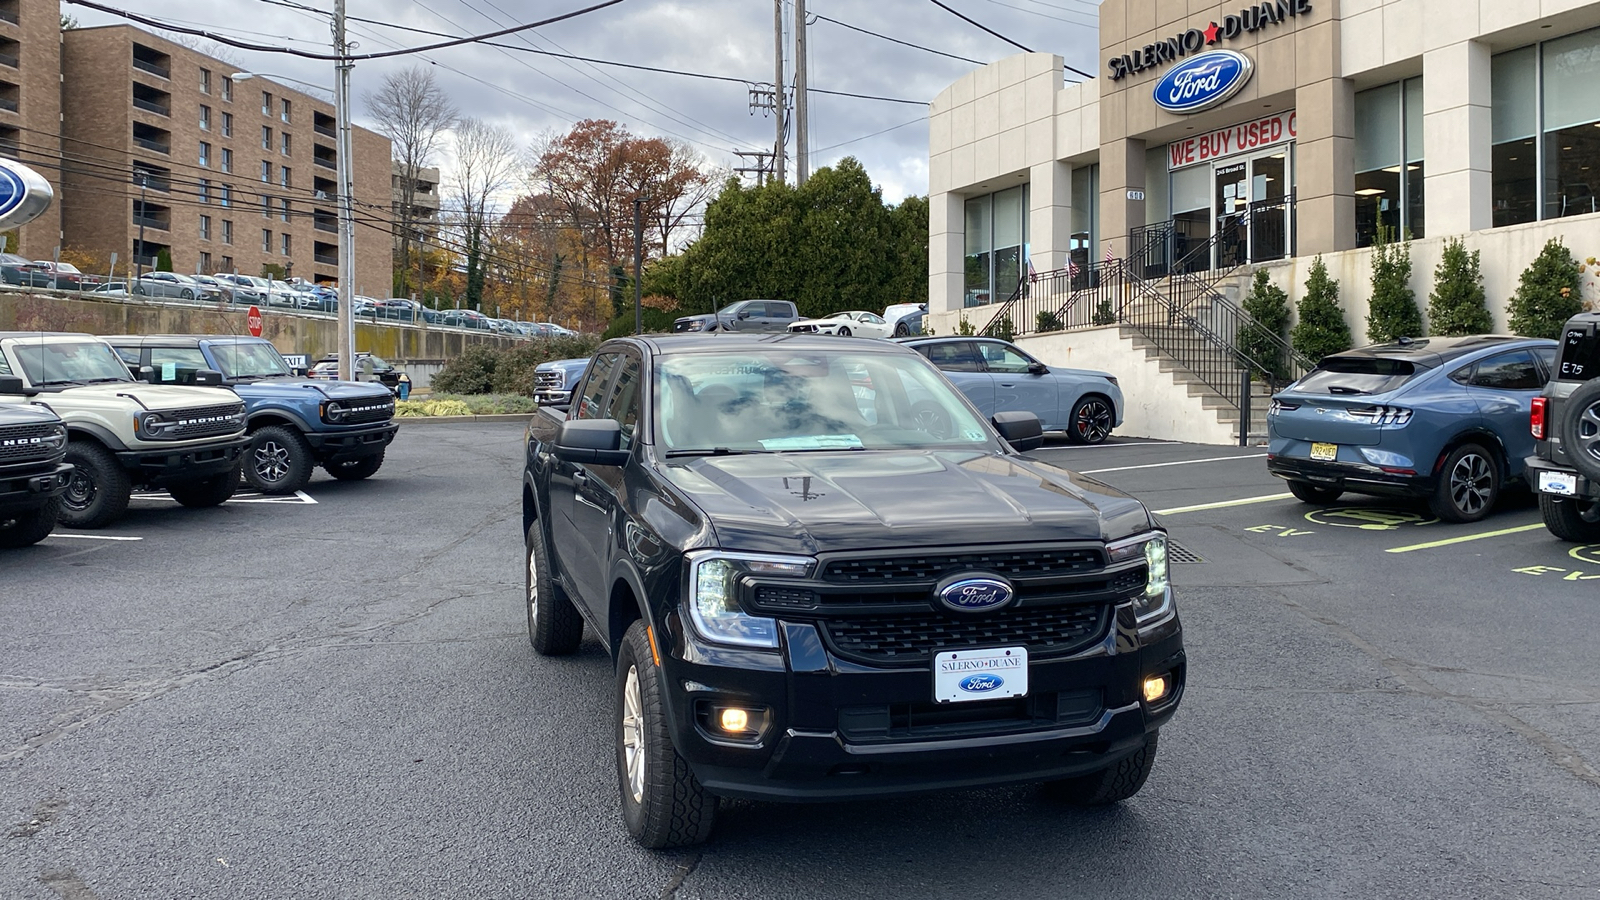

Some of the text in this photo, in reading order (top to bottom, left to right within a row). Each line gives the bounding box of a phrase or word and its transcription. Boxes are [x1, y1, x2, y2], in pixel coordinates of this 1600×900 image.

[1107, 28, 1204, 81] SALERNO
[1170, 61, 1222, 103] Ford
[1170, 139, 1195, 166] WE
[1199, 130, 1232, 160] BUY
[1236, 117, 1282, 150] USED
[249, 316, 261, 329] STOP
[352, 404, 388, 412] BRONCO
[179, 415, 232, 425] BRONCO
[1244, 524, 1315, 537] EV
[959, 586, 997, 605] Ford
[941, 657, 1021, 672] SALERNO DUANE
[967, 676, 996, 690] Ford
